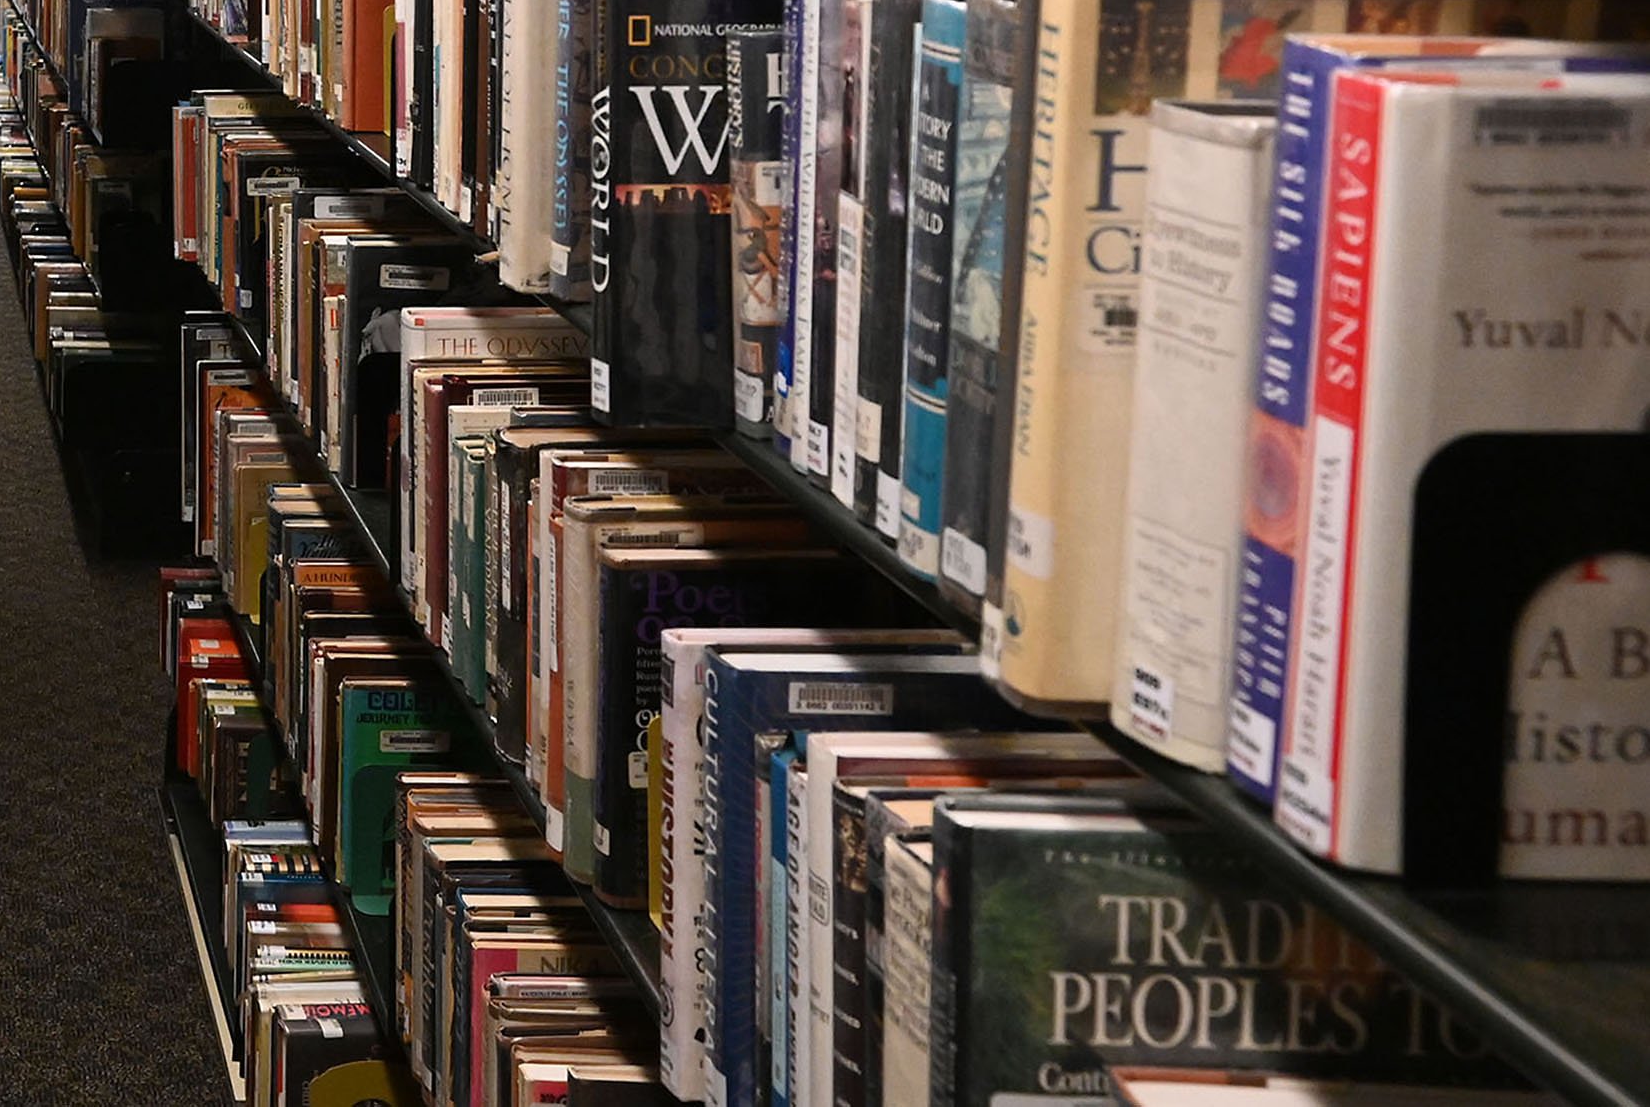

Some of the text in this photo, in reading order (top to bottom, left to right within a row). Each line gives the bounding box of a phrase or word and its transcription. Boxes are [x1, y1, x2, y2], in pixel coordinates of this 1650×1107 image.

[628, 54, 728, 80] CONC
[654, 24, 714, 36] NATIONAL
[727, 40, 745, 150] HISTORY'S
[590, 84, 613, 295] WORLD
[922, 151, 946, 172] THE
[1028, 21, 1062, 280] HERITAGE
[797, 149, 814, 307] WILDERNESS
[1324, 130, 1373, 392] SAPIENS
[438, 337, 589, 359] THE ODYSSEY
[794, 314, 811, 404] FAMILY
[1453, 306, 1582, 350] Yuval
[1233, 549, 1264, 706] FRANKOPA
[1530, 627, 1578, 680] A
[701, 668, 721, 1064] CULTURAL LITERA
[786, 788, 803, 999] AGE OF ANGER
[1048, 970, 1368, 1054] PEOPLES
